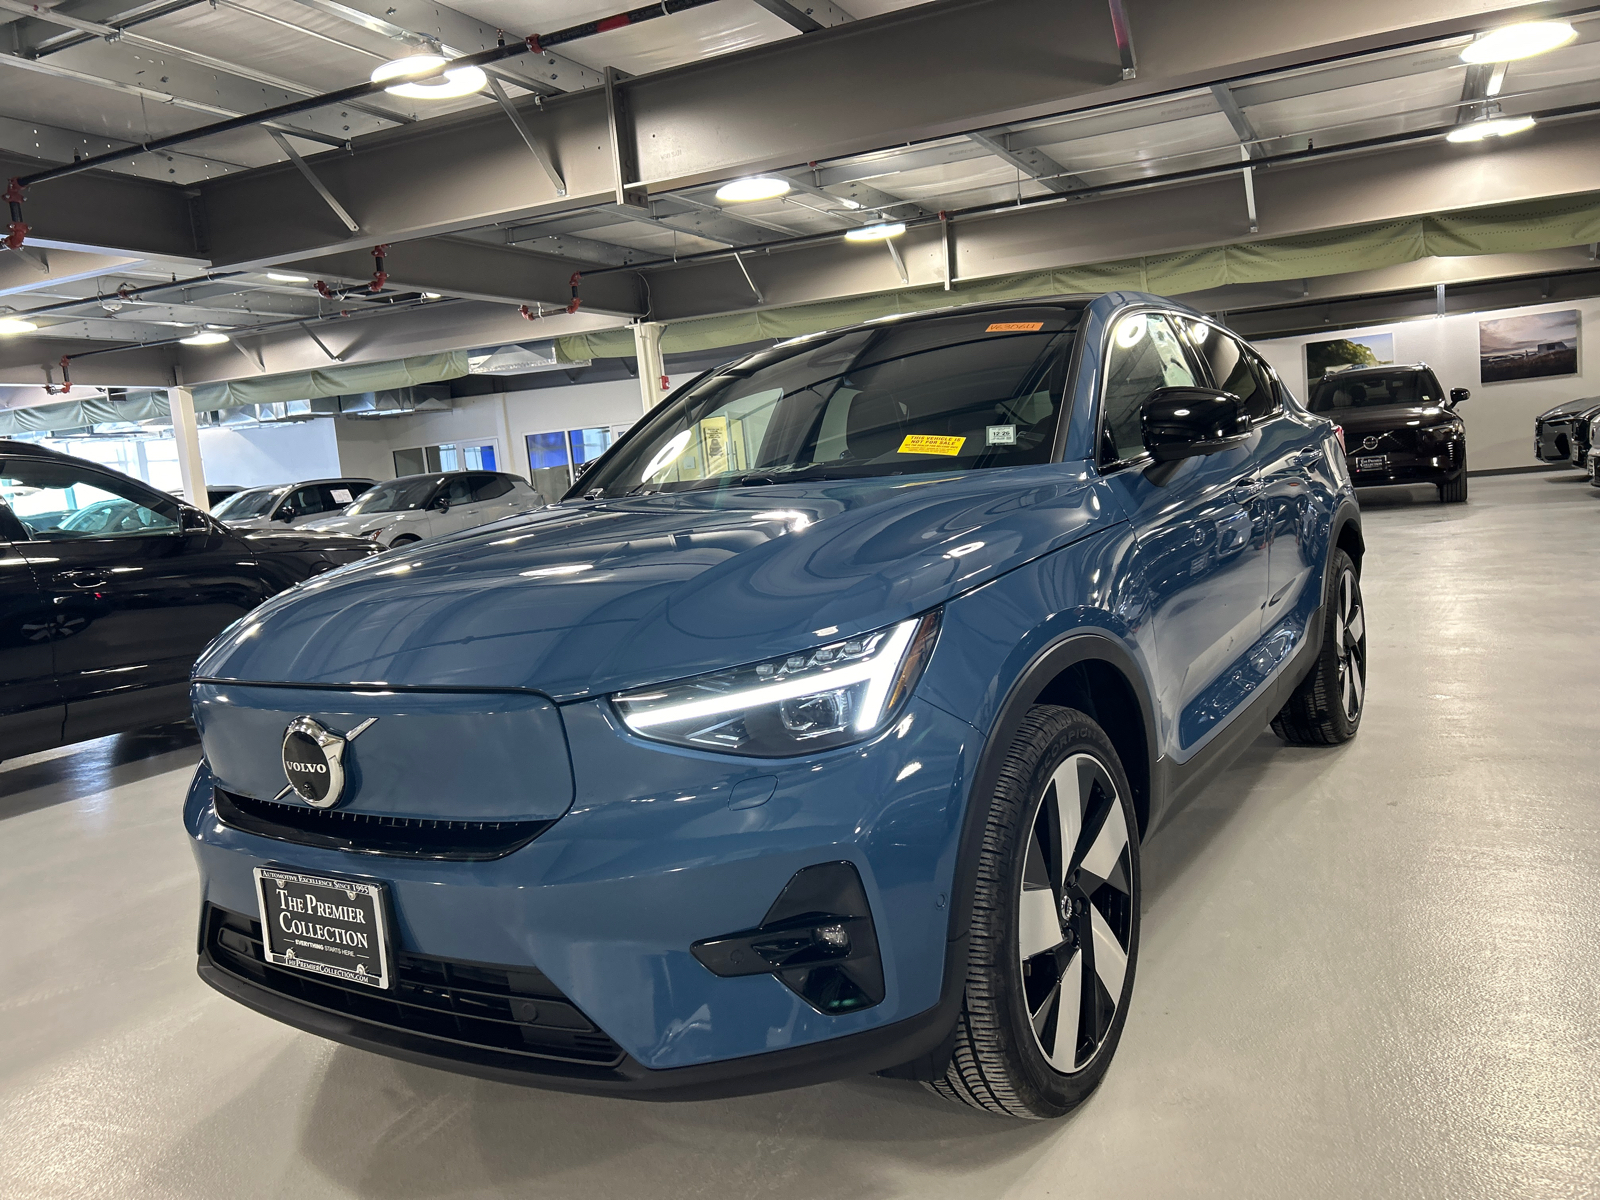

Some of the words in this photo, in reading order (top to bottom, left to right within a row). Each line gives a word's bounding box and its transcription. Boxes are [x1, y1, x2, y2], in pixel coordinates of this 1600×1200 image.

[286, 761, 327, 774] VOLVO
[352, 884, 370, 894] 1995
[276, 888, 304, 913] THE
[305, 893, 366, 924] PREMIER
[279, 911, 369, 949] COLLECTION
[295, 939, 324, 951] EVERYTHING
[324, 945, 342, 955] STARTS
